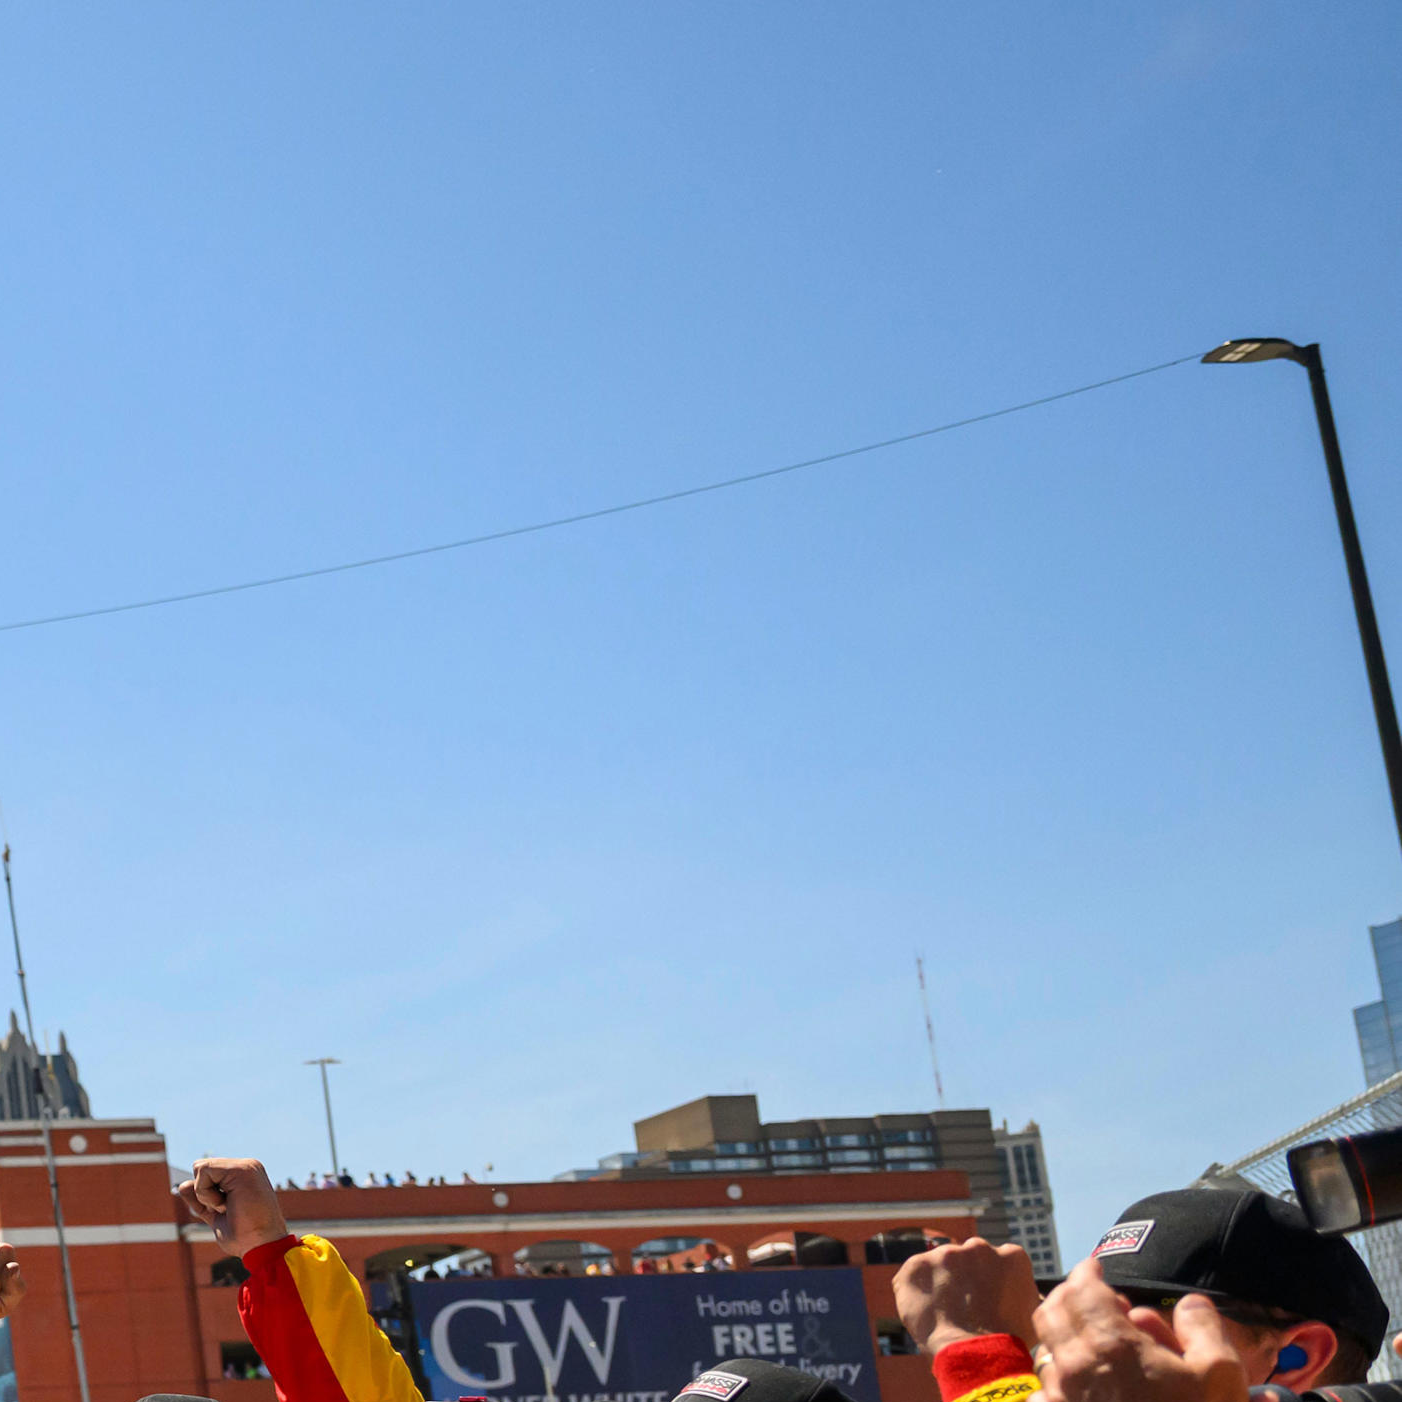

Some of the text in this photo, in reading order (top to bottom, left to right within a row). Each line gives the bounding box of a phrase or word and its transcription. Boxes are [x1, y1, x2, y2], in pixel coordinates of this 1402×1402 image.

[430, 1290, 830, 1390] GW Home of the
[712, 1323, 797, 1357] FREE
